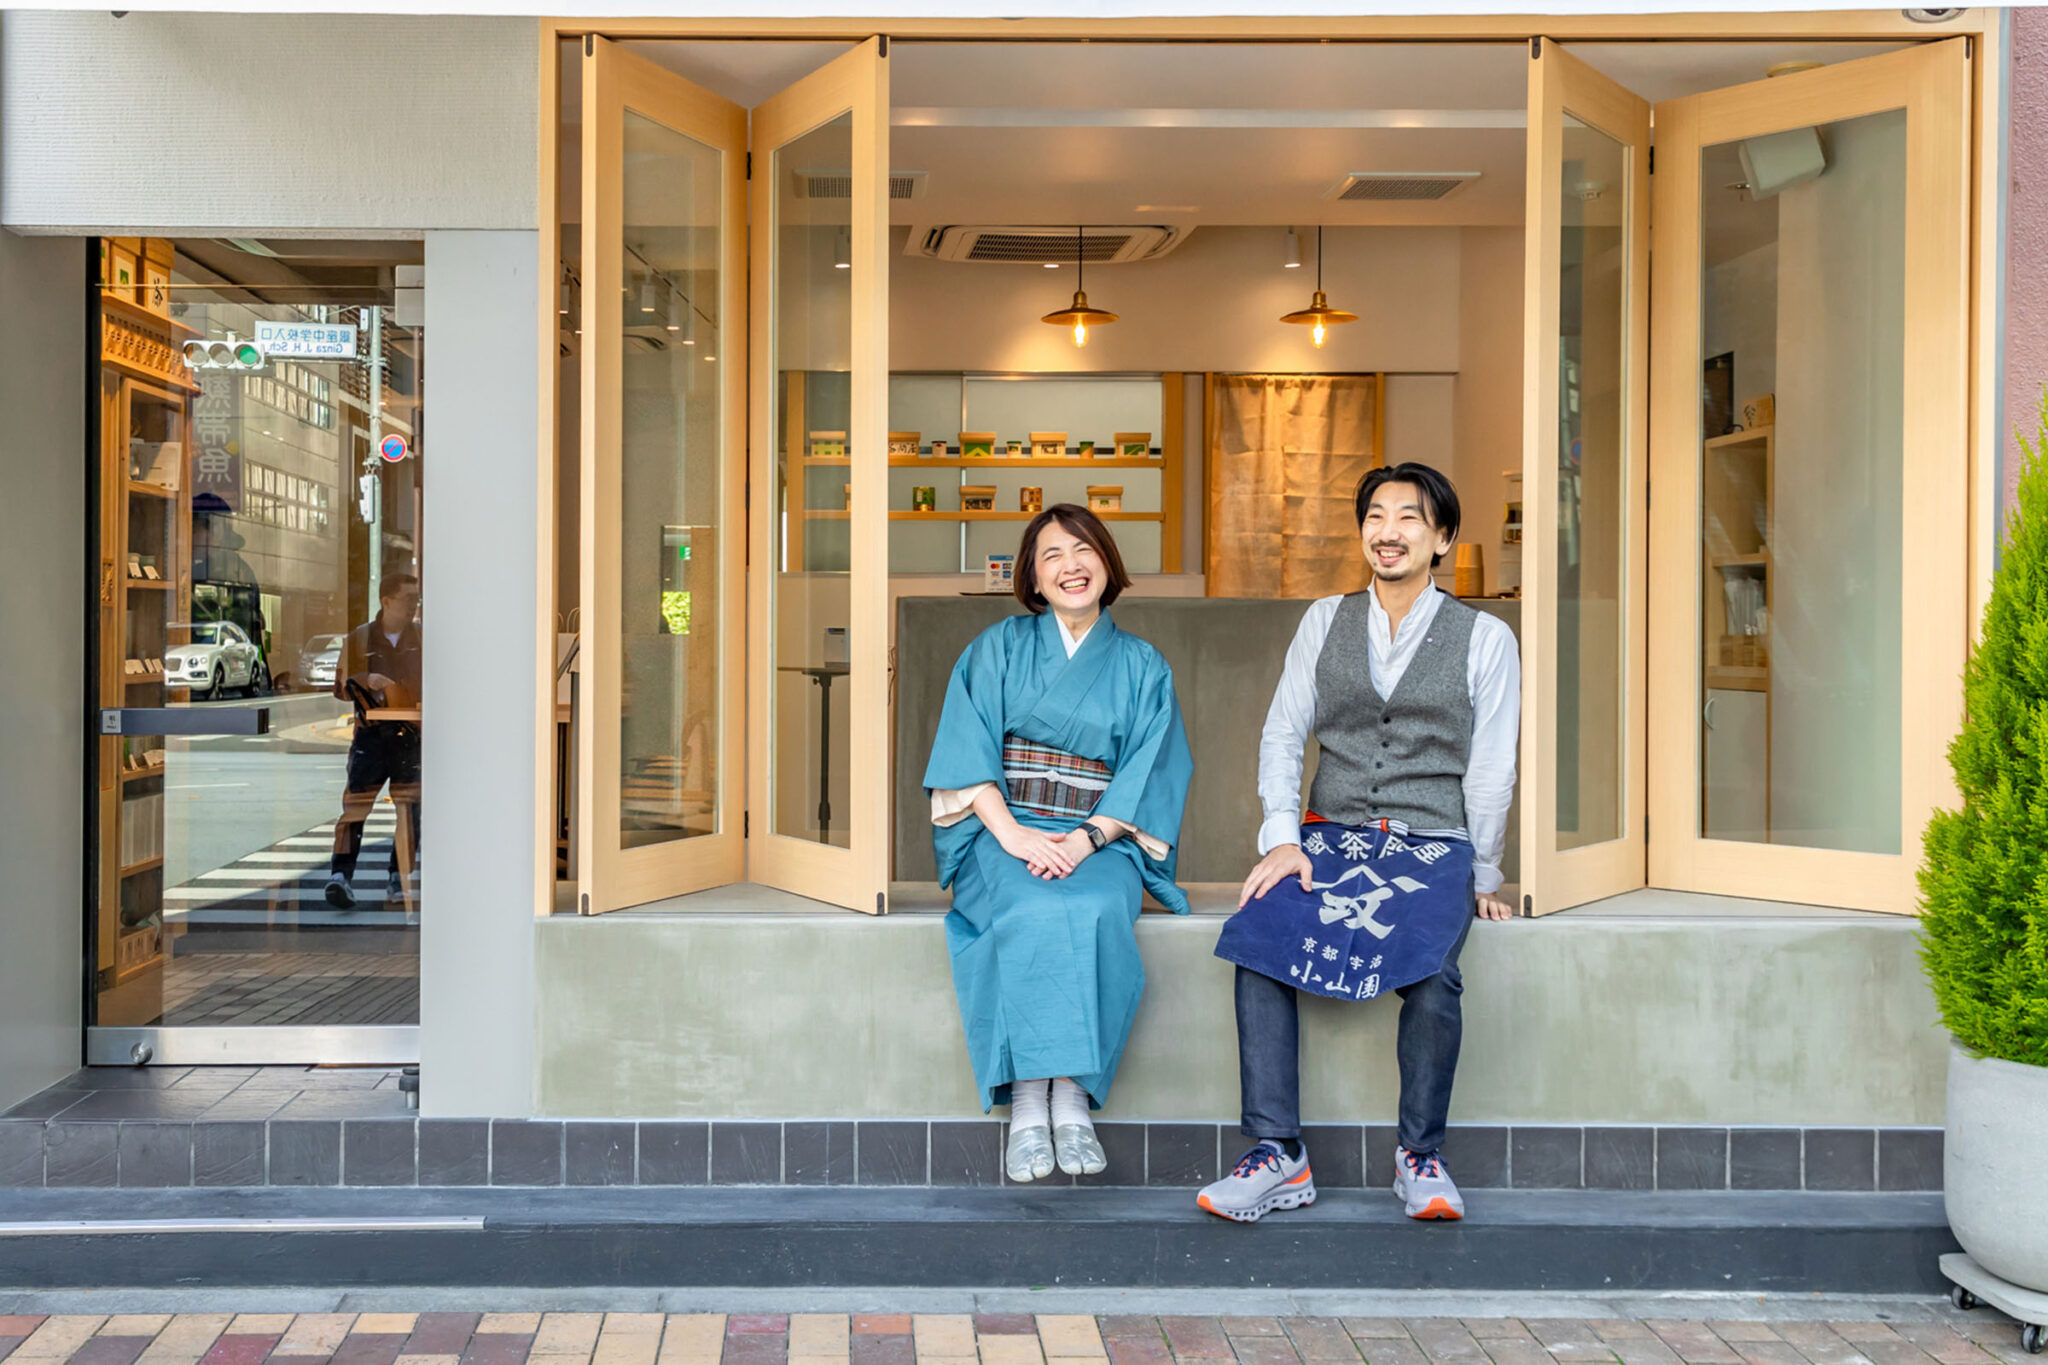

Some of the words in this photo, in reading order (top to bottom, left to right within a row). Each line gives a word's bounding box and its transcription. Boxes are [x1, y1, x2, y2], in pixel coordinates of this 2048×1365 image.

[1301, 936, 1383, 970] 京都宇治
[1289, 959, 1380, 1000] 小山園
